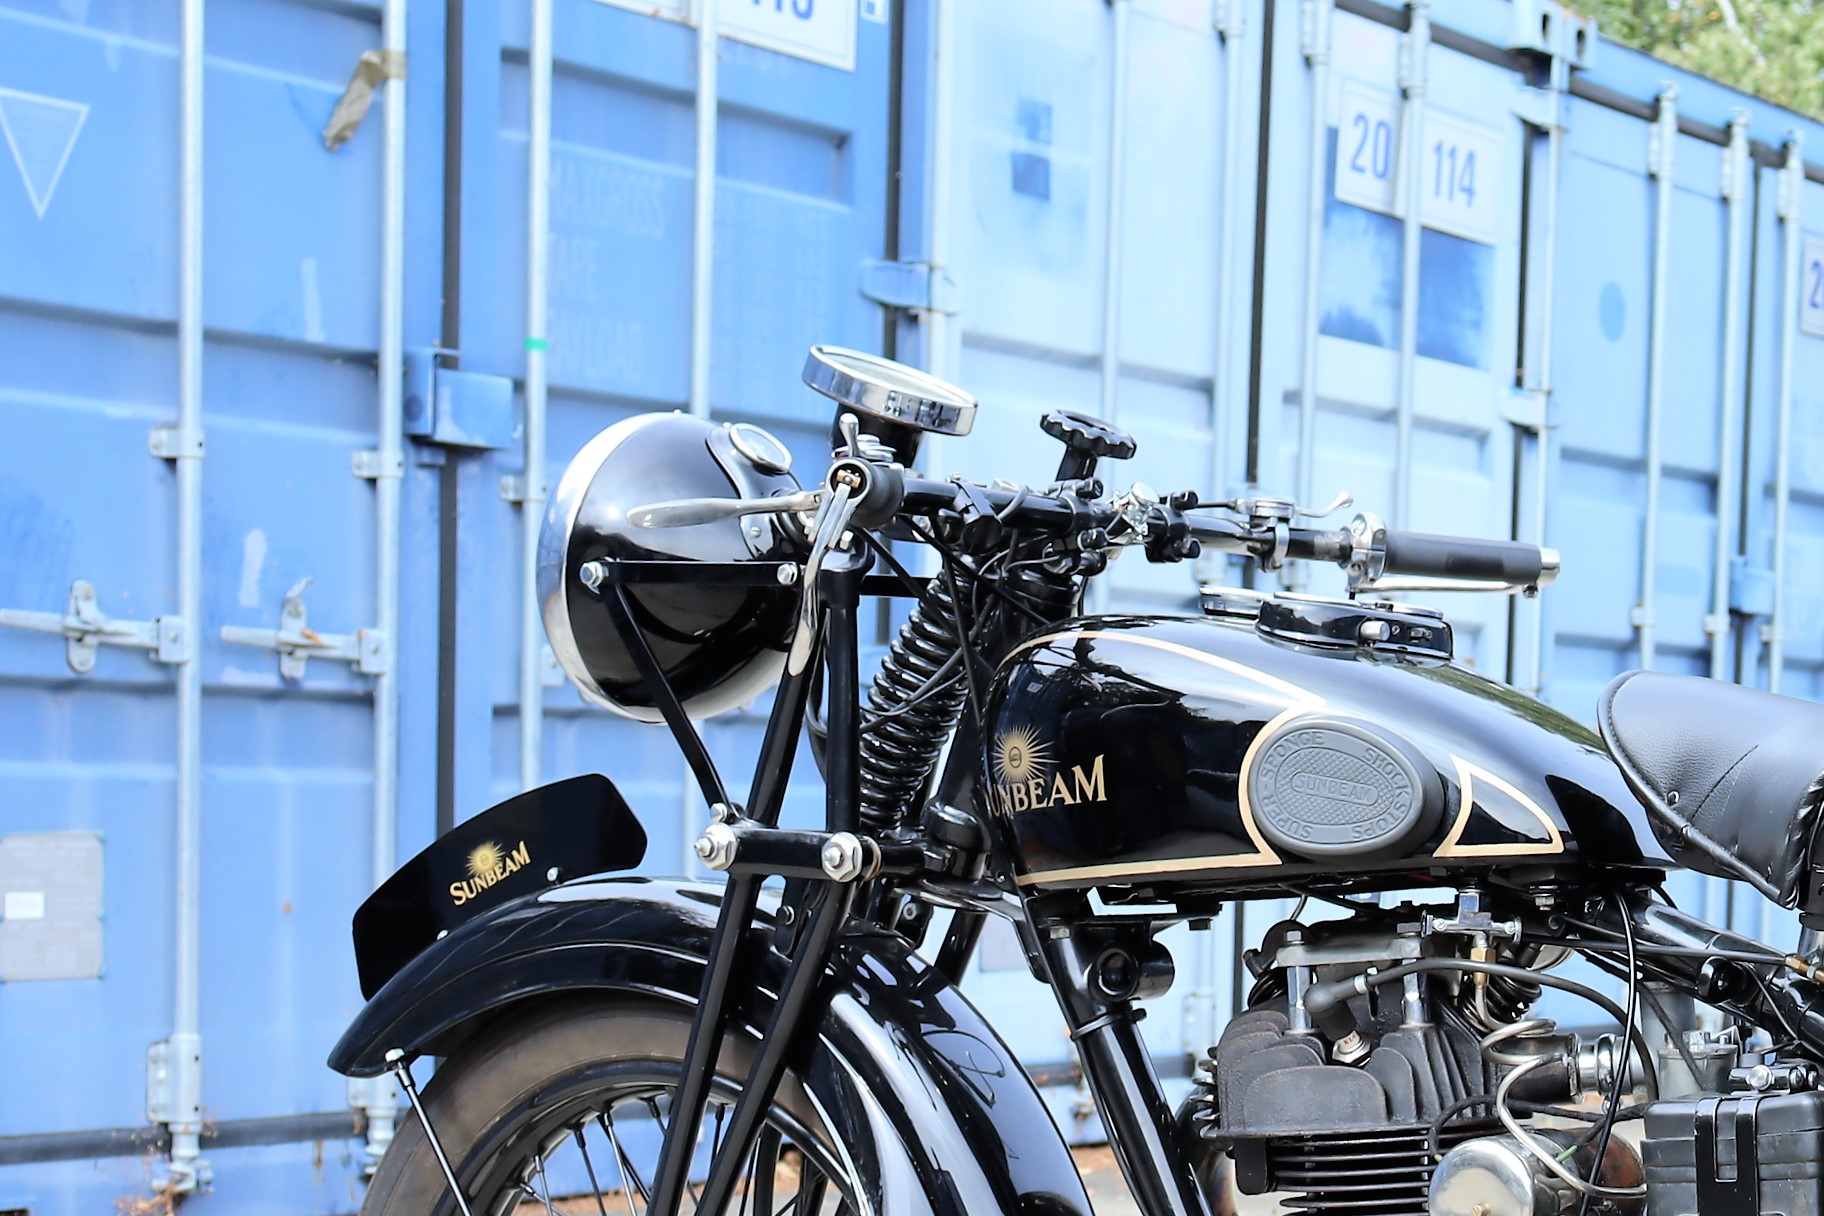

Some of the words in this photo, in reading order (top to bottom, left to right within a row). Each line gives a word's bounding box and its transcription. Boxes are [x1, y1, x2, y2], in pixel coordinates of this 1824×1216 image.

[1351, 111, 1391, 180] 20
[1434, 140, 1476, 208] 114
[986, 754, 1107, 817] UNBEAM
[1294, 775, 1374, 803] SUNBEAM
[449, 840, 531, 906] SUNBEAM
